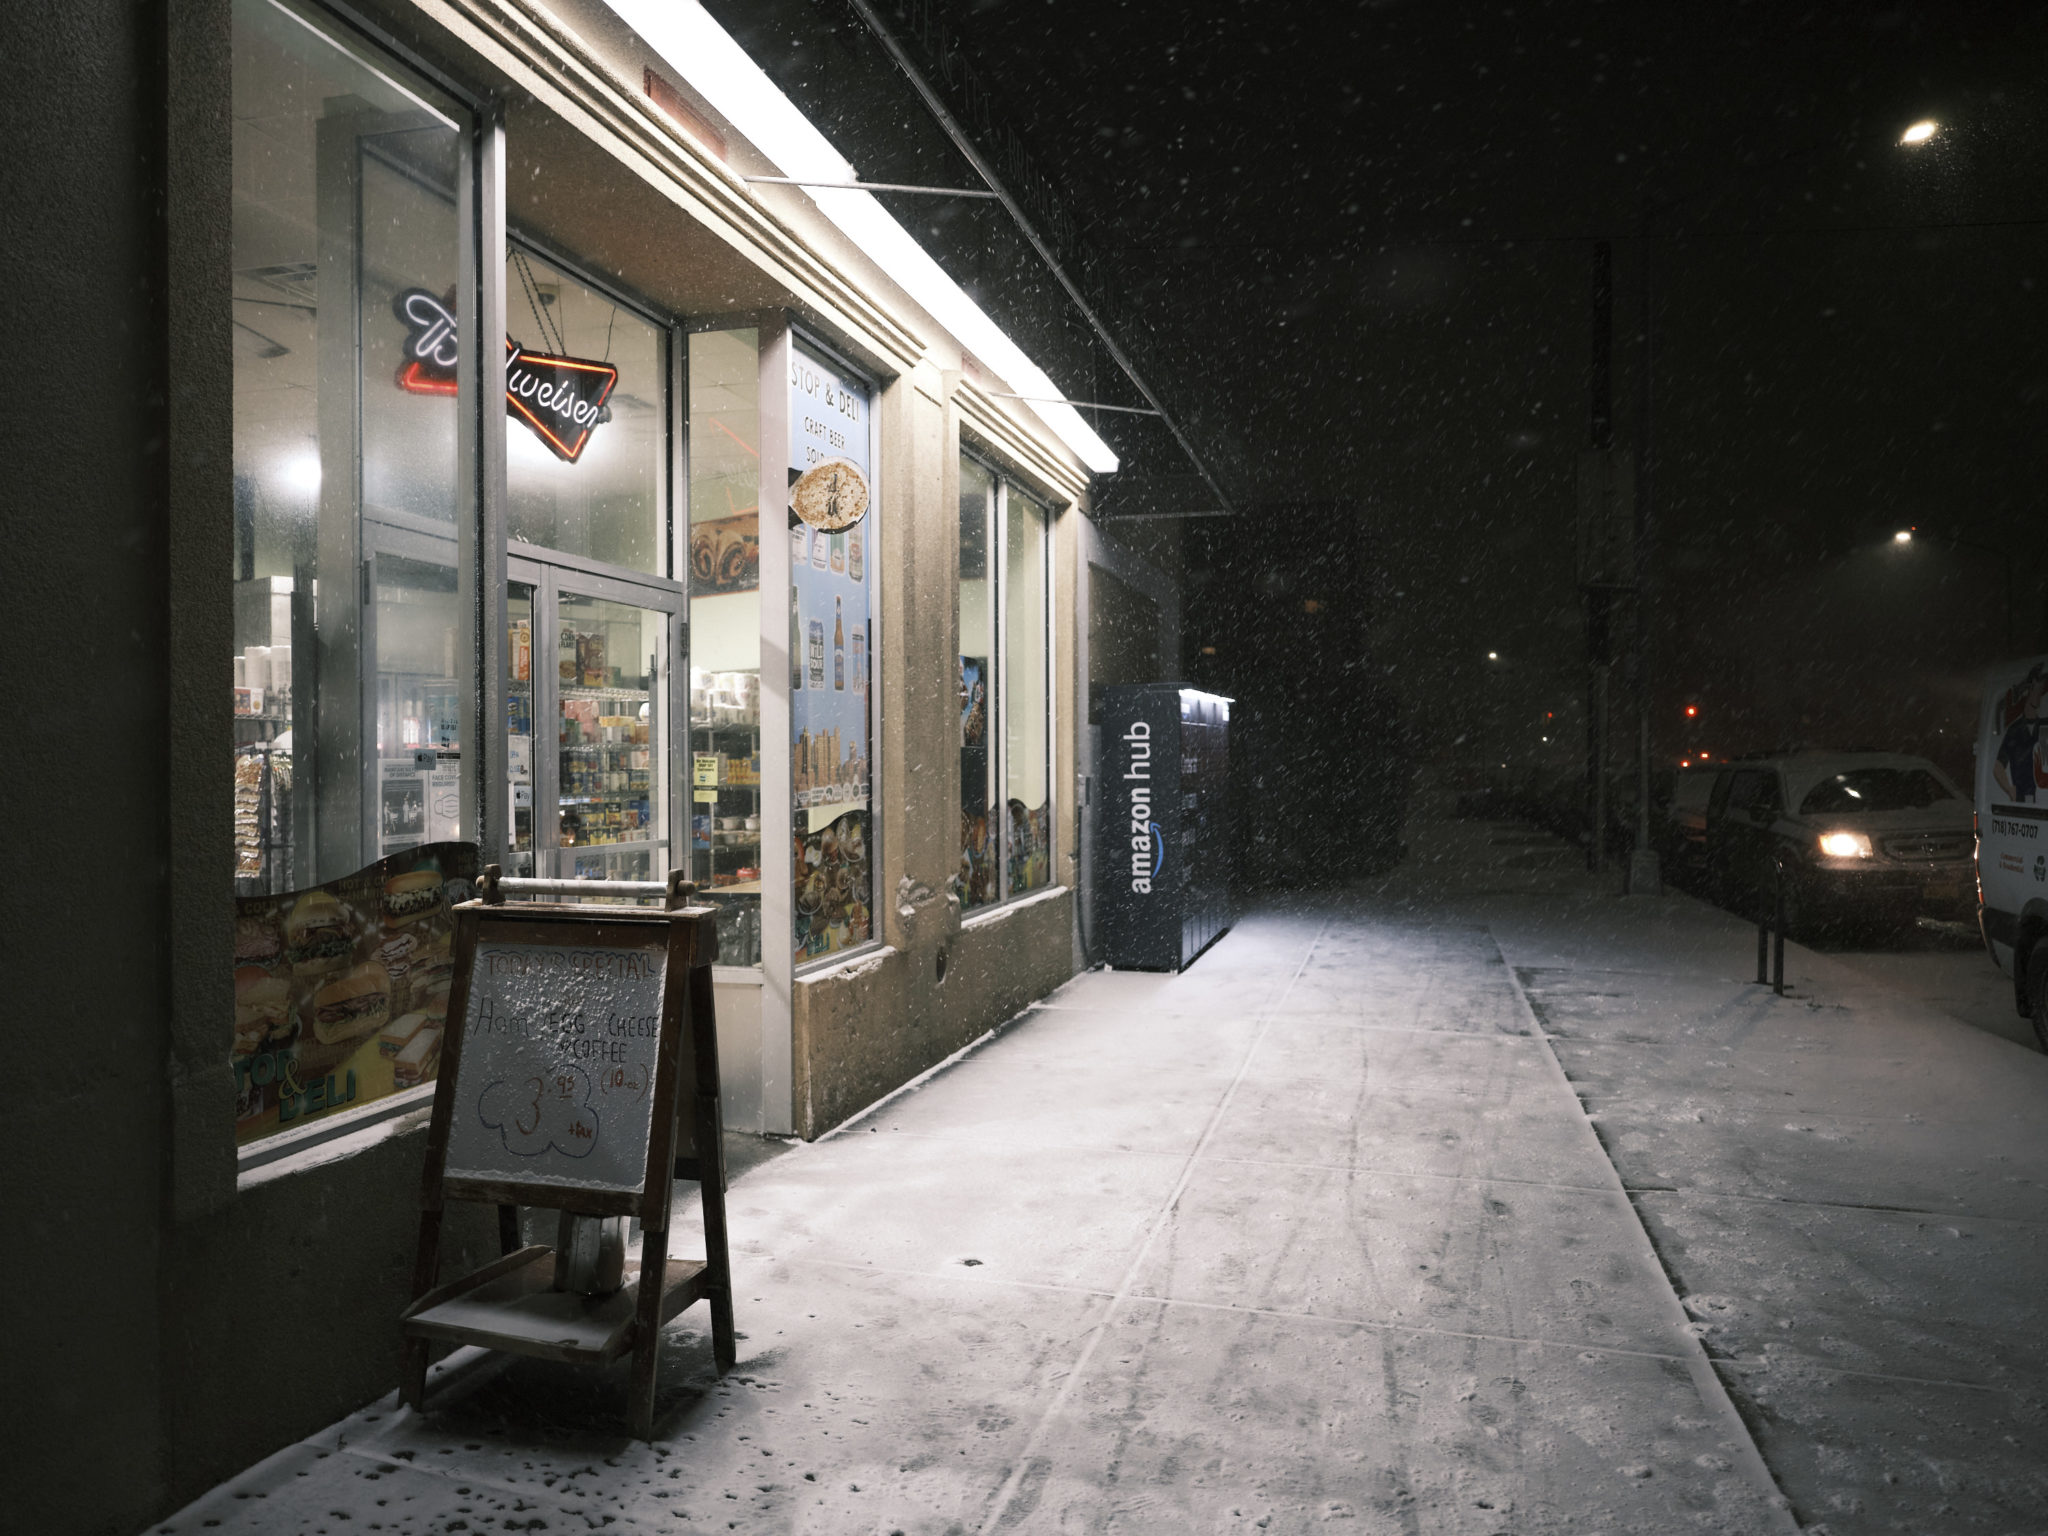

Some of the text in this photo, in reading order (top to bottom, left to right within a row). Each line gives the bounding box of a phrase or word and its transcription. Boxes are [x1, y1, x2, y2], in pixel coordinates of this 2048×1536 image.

[791, 361, 859, 422] STOP & DELI
[804, 416, 845, 451] CRAFT BEER
[423, 753, 434, 766] Pay
[521, 791, 530, 802] Pay
[1122, 721, 1151, 894] amazon hub
[1992, 819, 2038, 839] (718) 767-0707
[474, 998, 529, 1036] Ham
[549, 1012, 586, 1034] EGG
[607, 1013, 659, 1038] CHEESE
[572, 1039, 627, 1063] COFFEE
[280, 1069, 356, 1123] DELI
